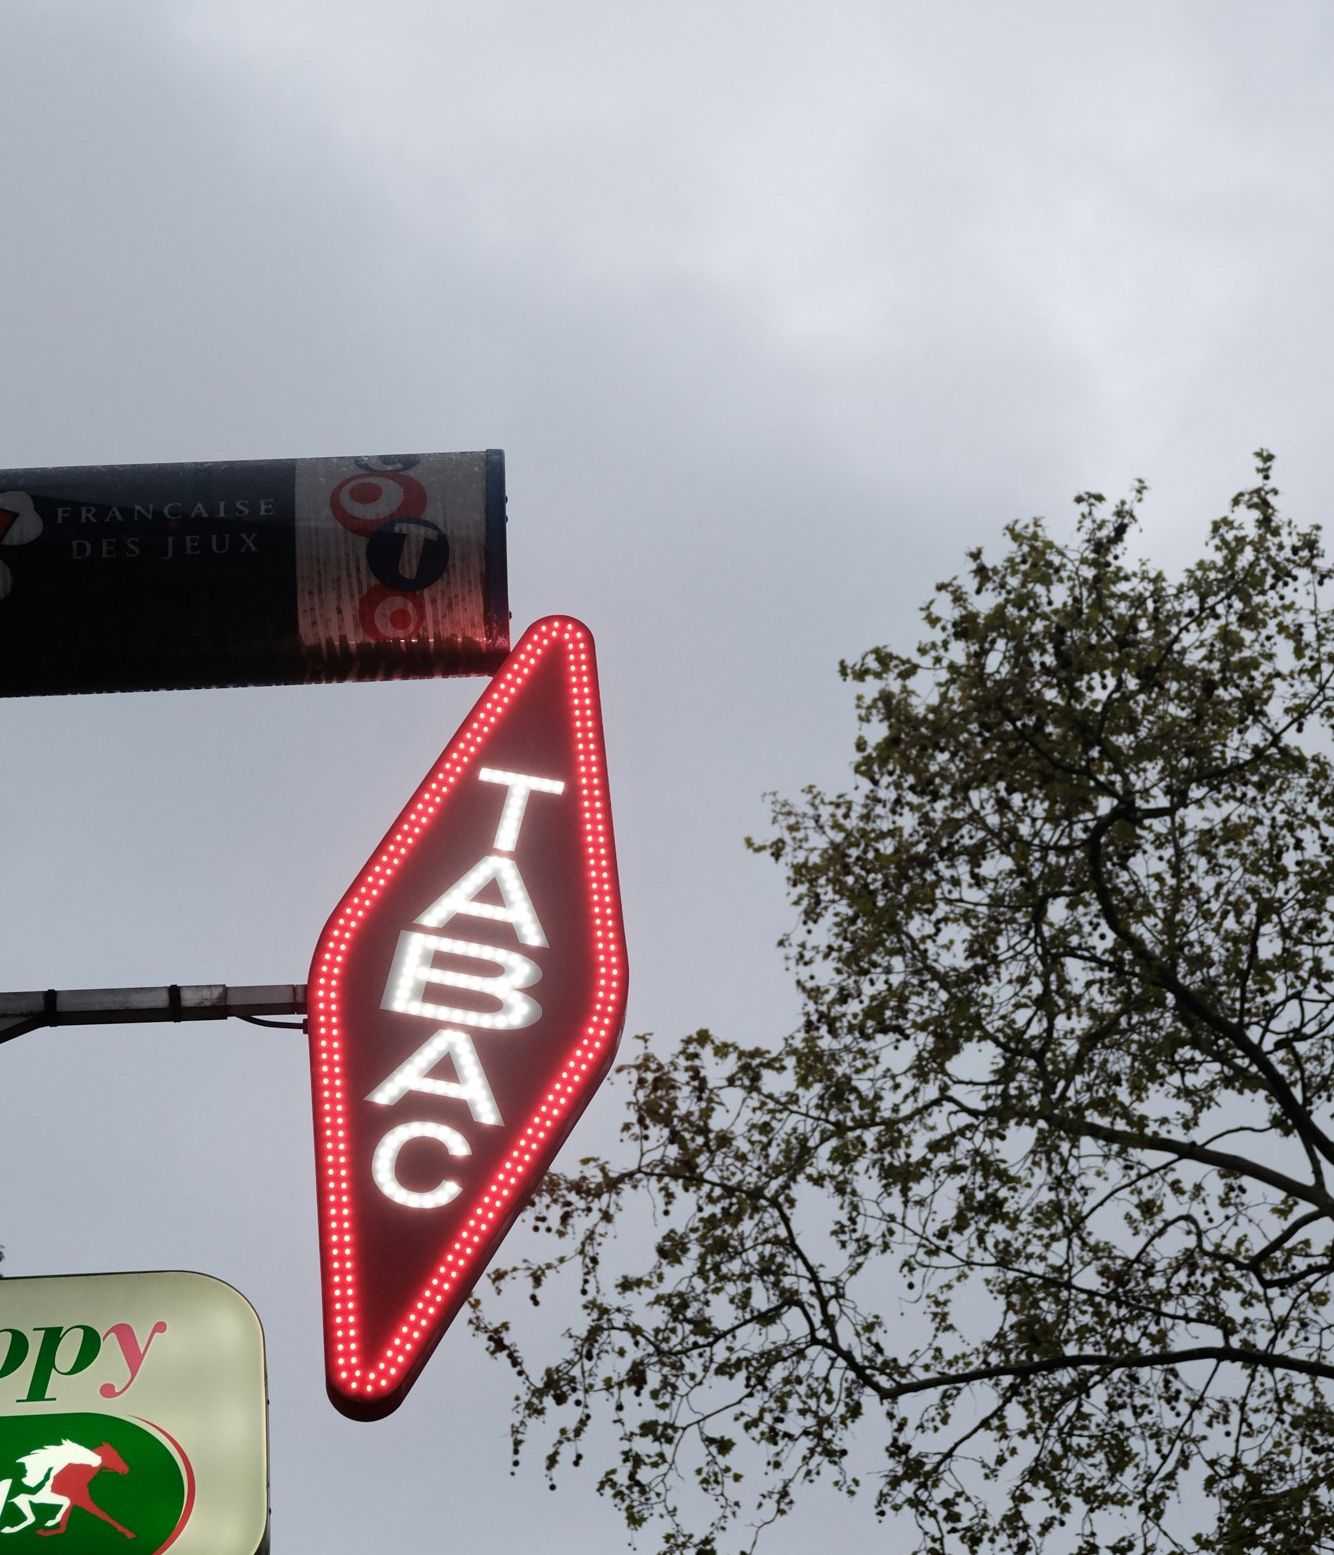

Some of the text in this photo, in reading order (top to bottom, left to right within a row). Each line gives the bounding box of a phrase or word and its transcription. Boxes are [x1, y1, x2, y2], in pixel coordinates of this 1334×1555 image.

[71, 532, 259, 560] DES JEUX
[363, 768, 565, 1209] TABAC
